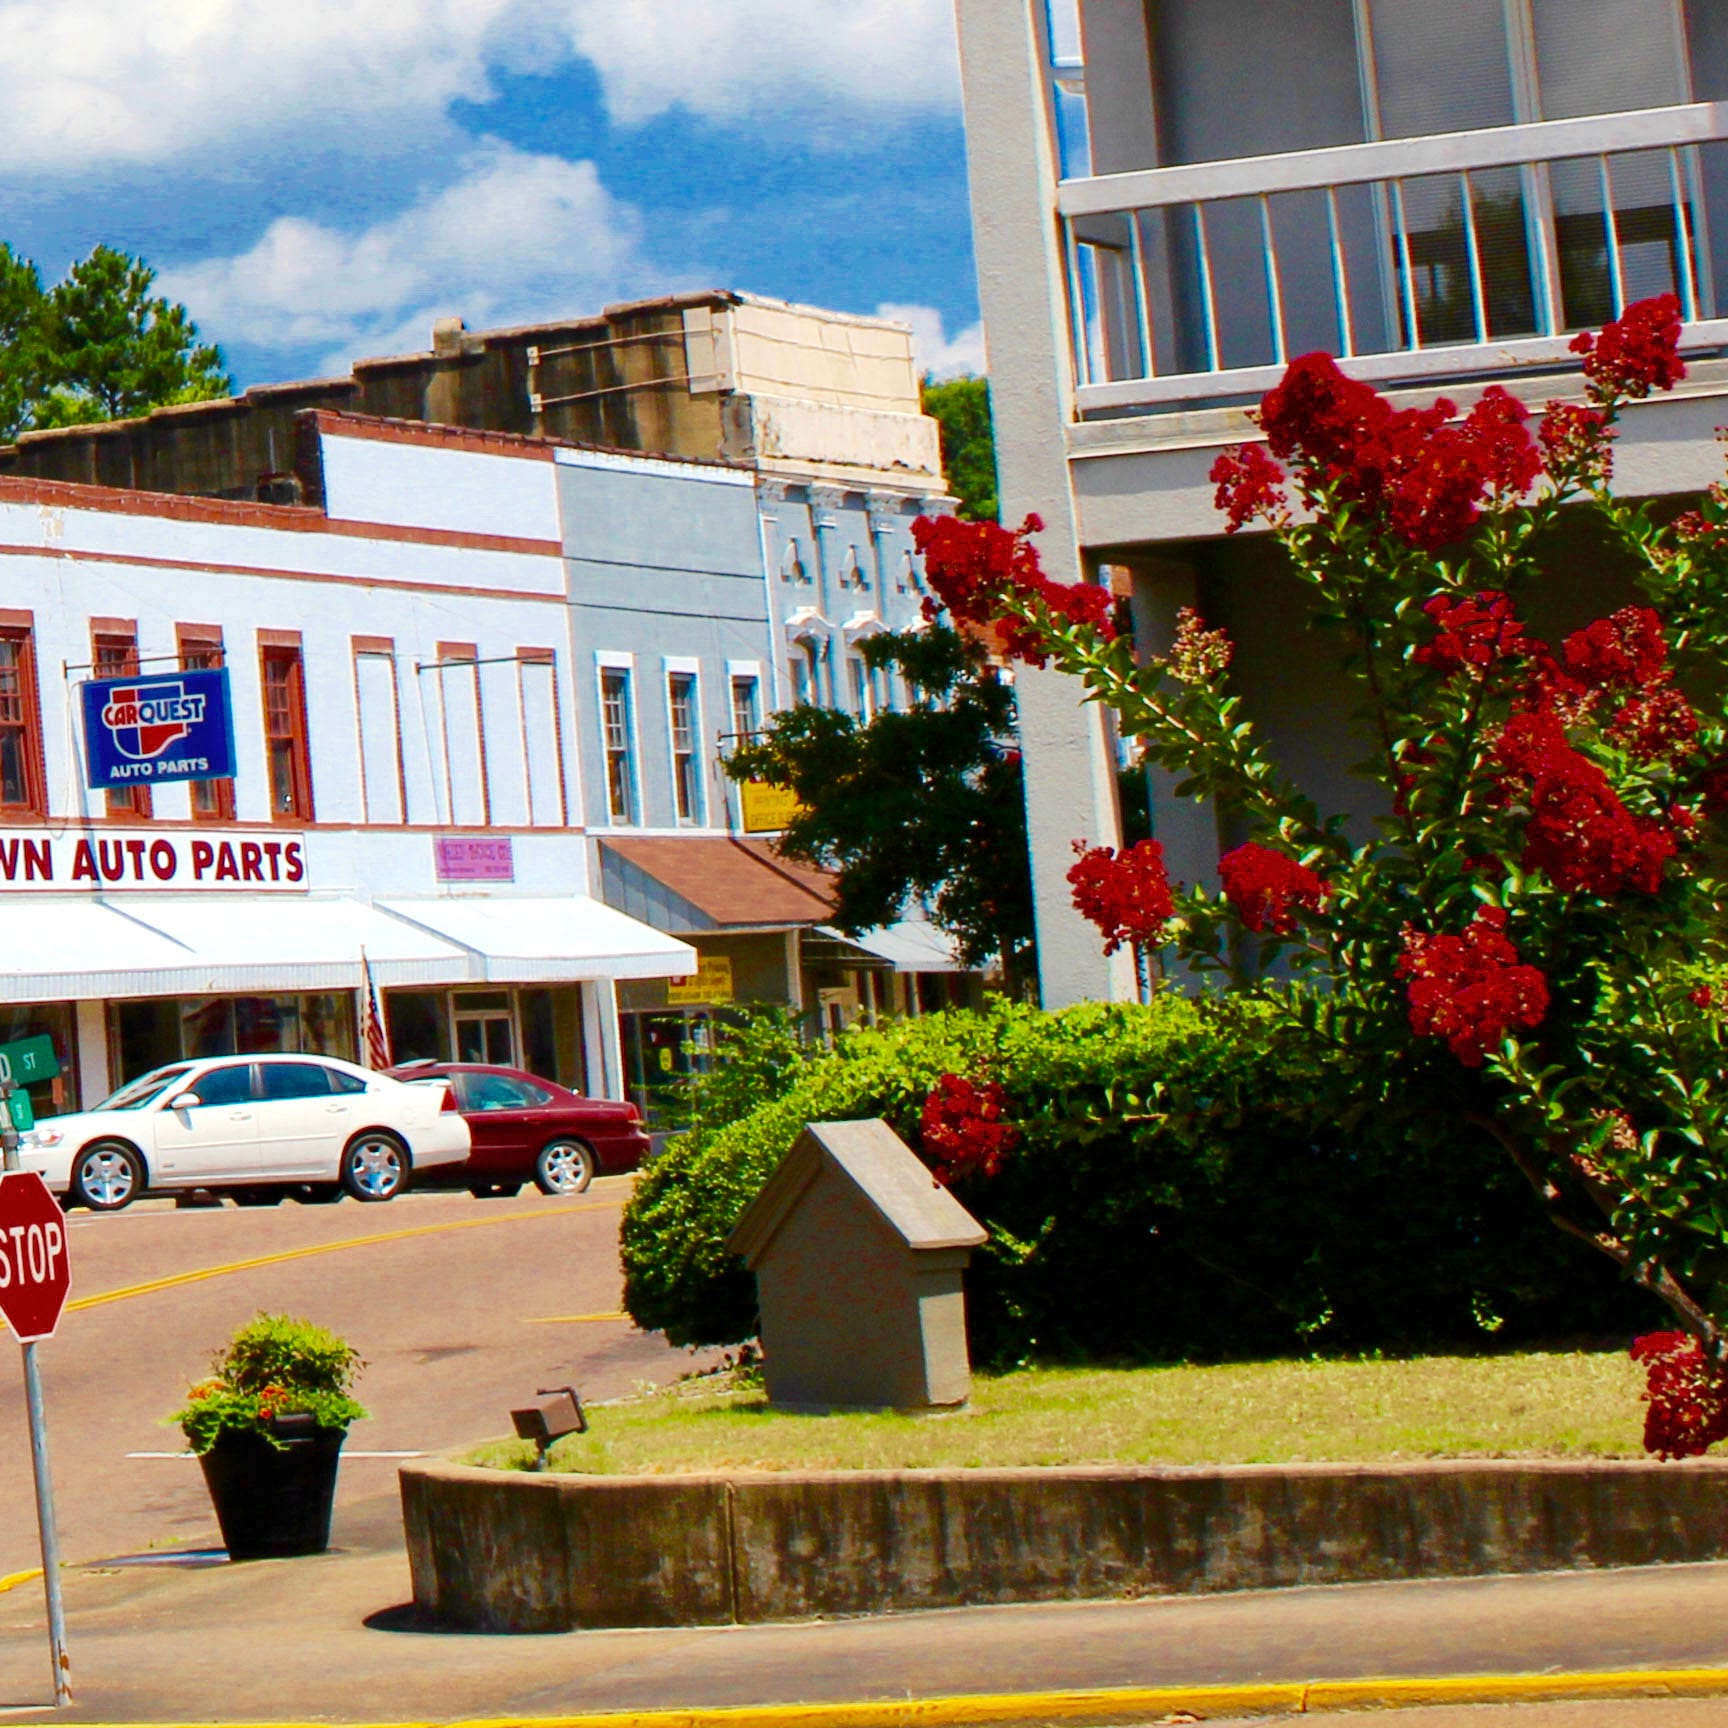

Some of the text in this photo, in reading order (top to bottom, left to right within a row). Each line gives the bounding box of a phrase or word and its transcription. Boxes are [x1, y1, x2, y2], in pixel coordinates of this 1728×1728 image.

[104, 698, 203, 727] CARQUEST
[110, 757, 209, 778] AUTO PARTS
[72, 838, 178, 882] AUTO
[191, 840, 305, 882] PARTS
[23, 1052, 36, 1071] ST
